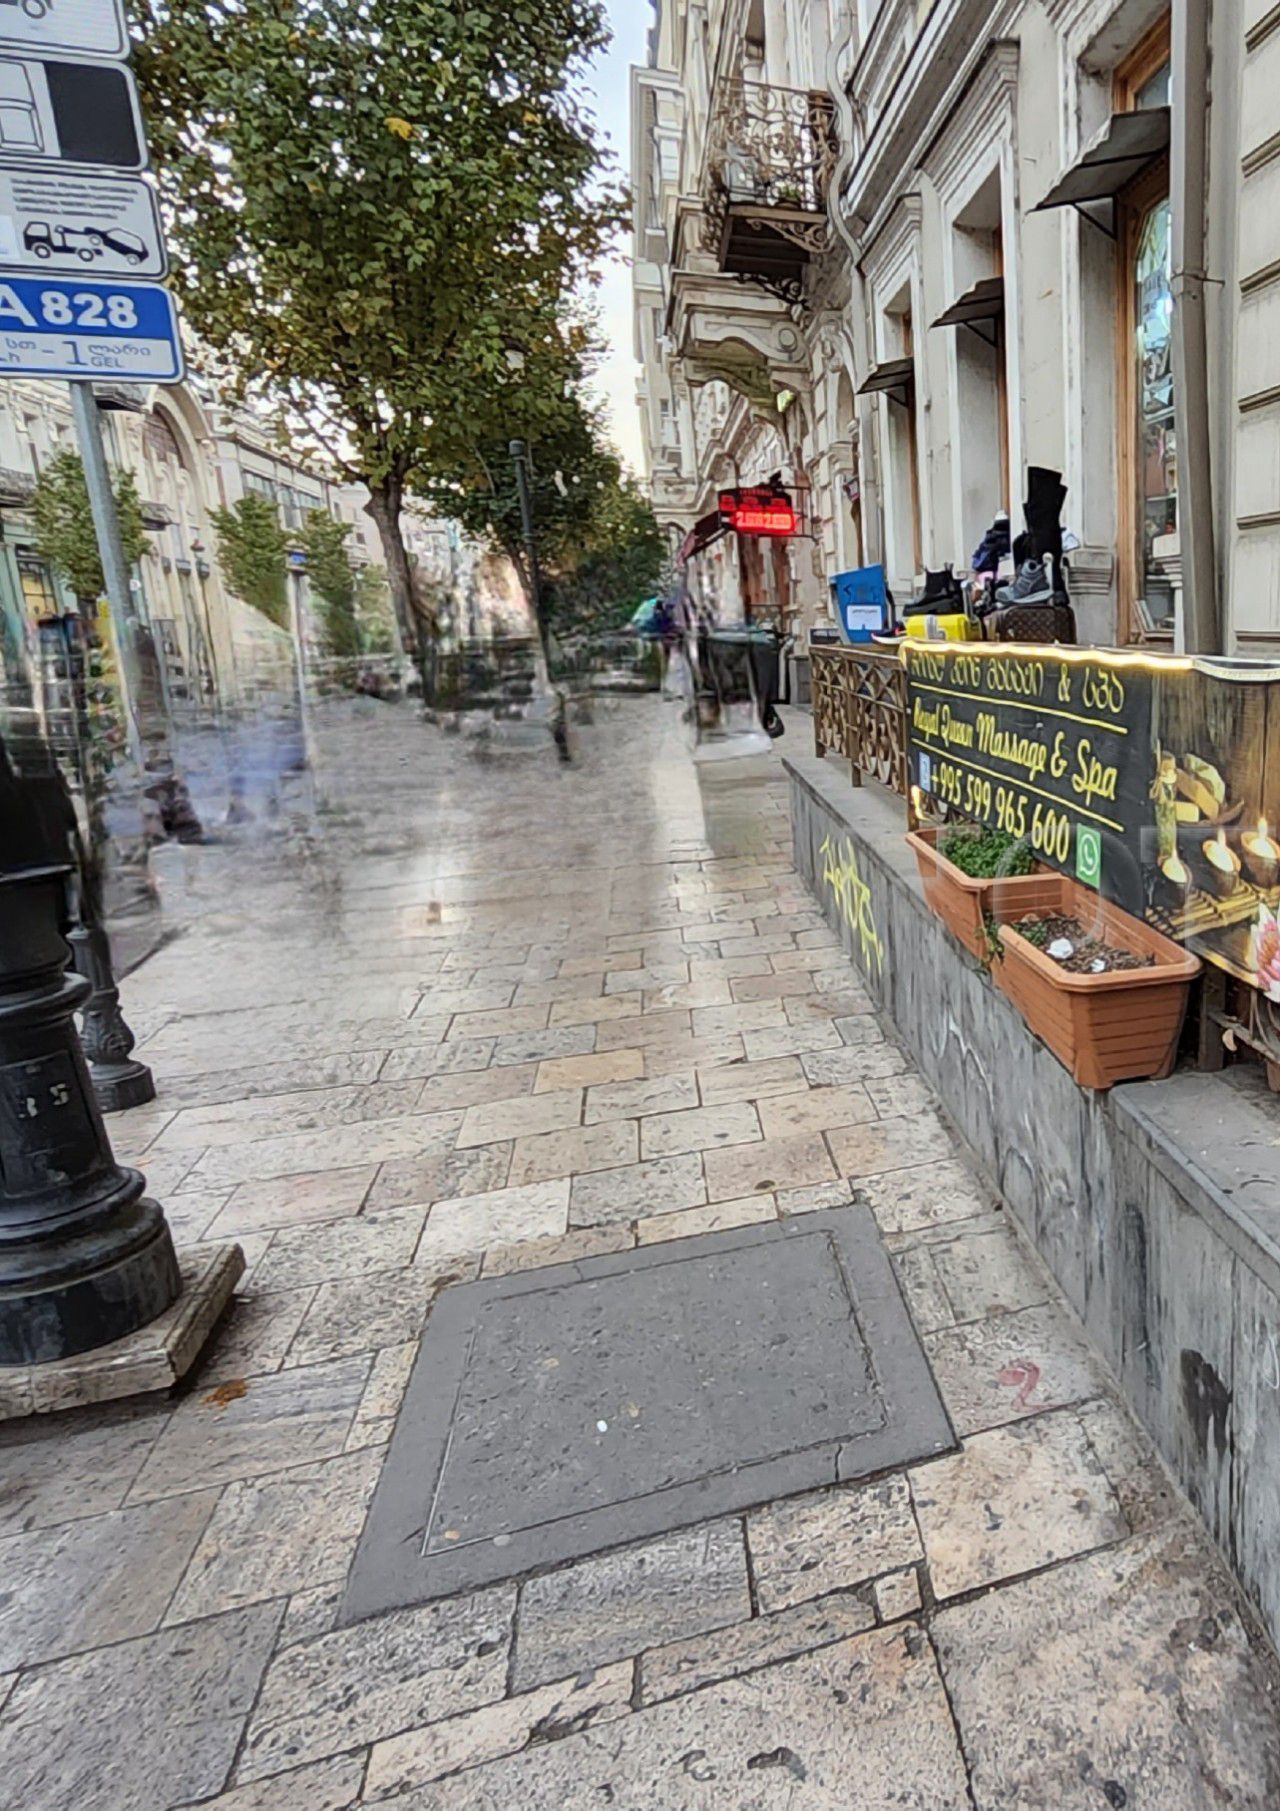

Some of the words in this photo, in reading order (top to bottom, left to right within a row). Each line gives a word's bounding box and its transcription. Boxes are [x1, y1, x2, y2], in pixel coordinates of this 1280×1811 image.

[976, 712, 1047, 781] Massage
[1072, 739, 1118, 806] Spa
[932, 762, 963, 806] +995
[964, 774, 991, 822] 599
[995, 786, 1028, 838] 965
[1032, 803, 1070, 864] 600
